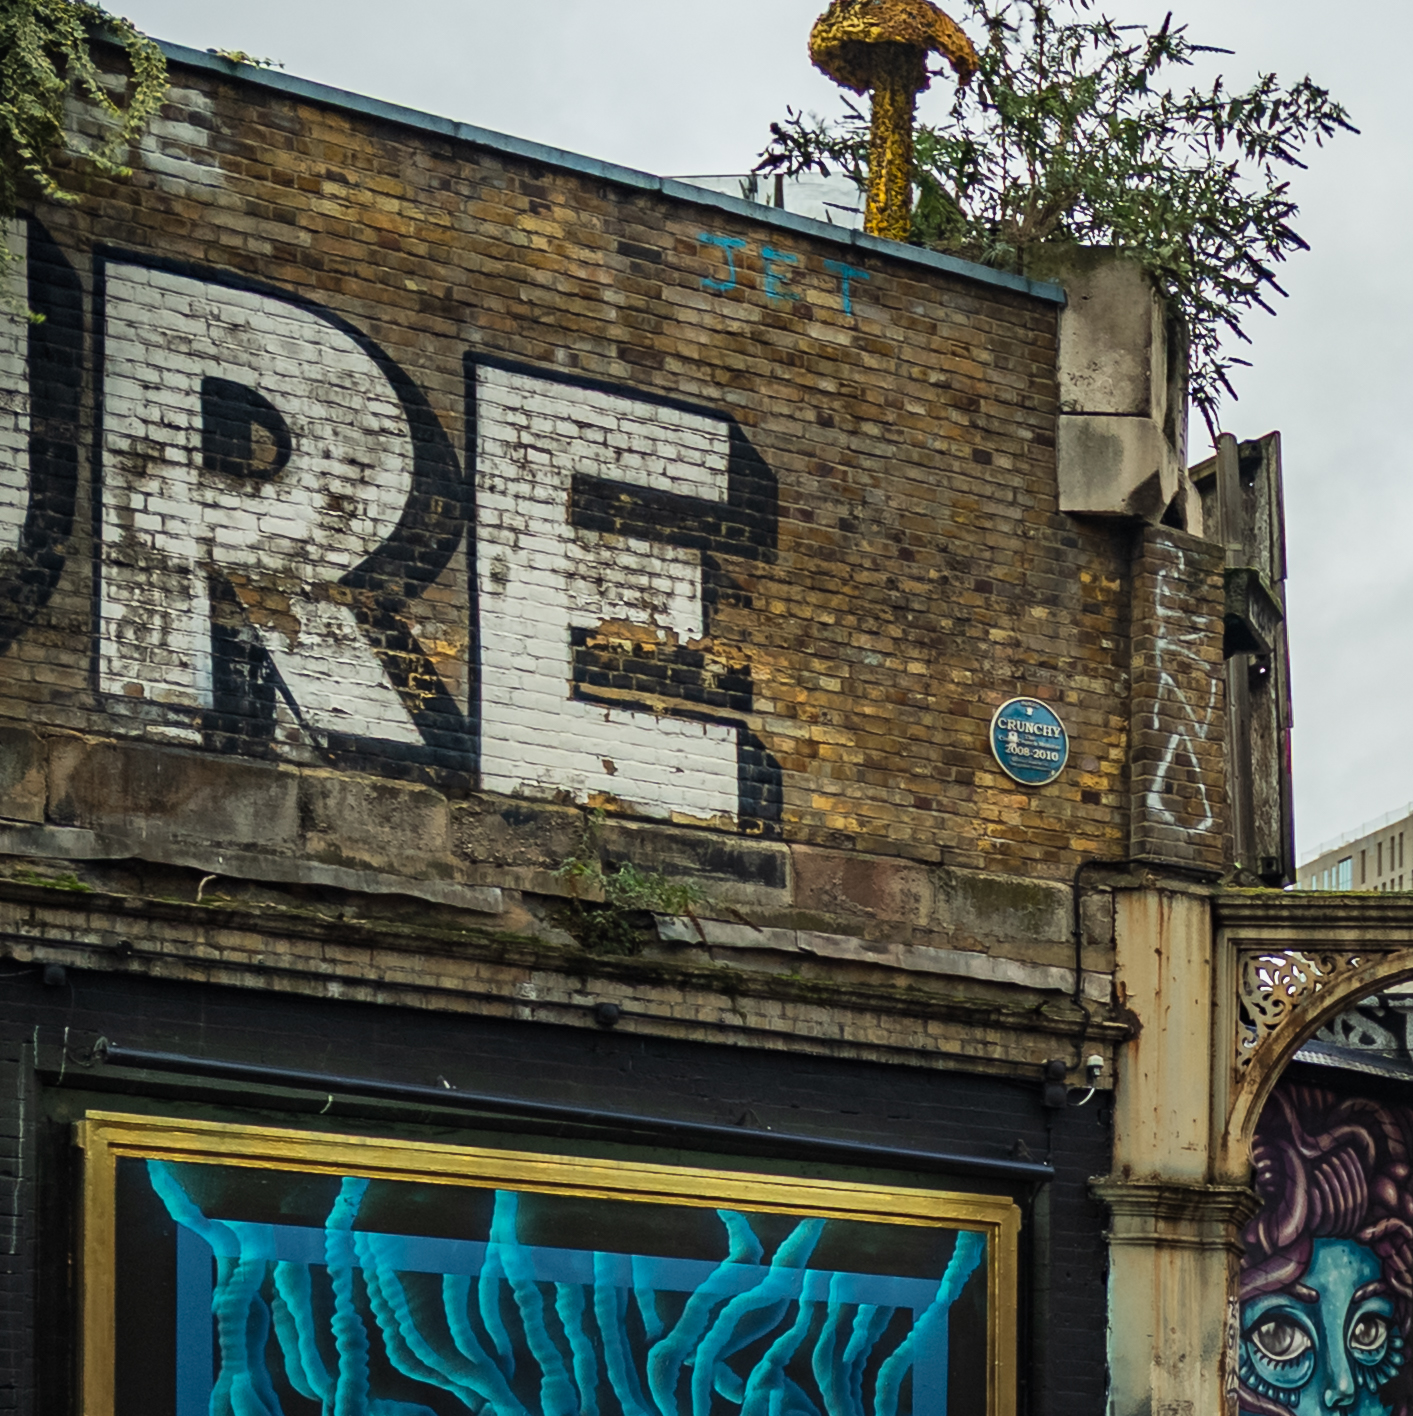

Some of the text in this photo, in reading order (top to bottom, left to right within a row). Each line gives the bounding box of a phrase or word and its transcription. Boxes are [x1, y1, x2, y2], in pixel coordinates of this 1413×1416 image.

[697, 232, 871, 317] JET
[0, 208, 783, 840] RE
[997, 716, 1062, 739] CRUNCHY
